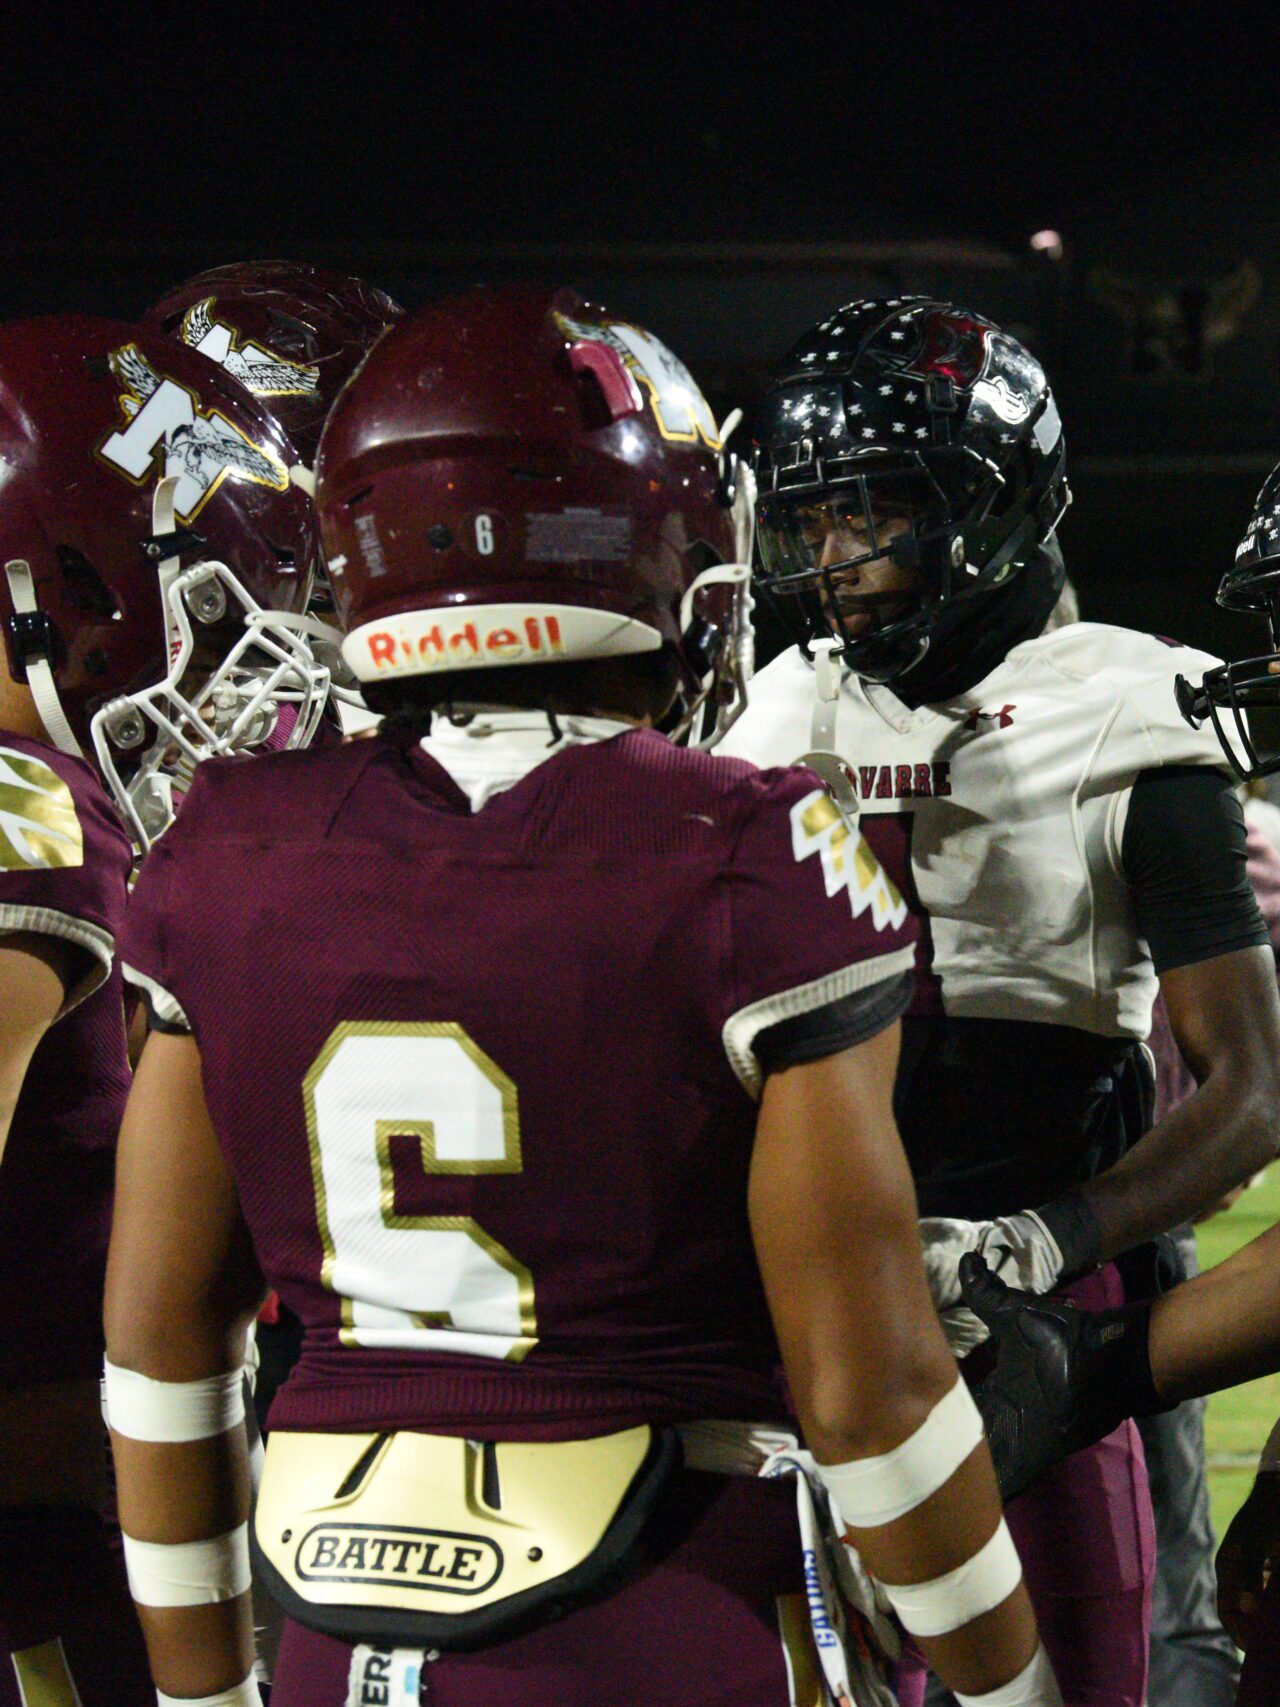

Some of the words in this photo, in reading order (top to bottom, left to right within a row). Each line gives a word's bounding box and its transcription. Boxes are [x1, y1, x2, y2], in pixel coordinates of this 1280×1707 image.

[475, 515, 494, 554] 6
[368, 616, 565, 668] Riddell
[838, 762, 952, 799] VARRE
[301, 1020, 539, 1363] 6
[310, 1536, 482, 1582] BATTLE
